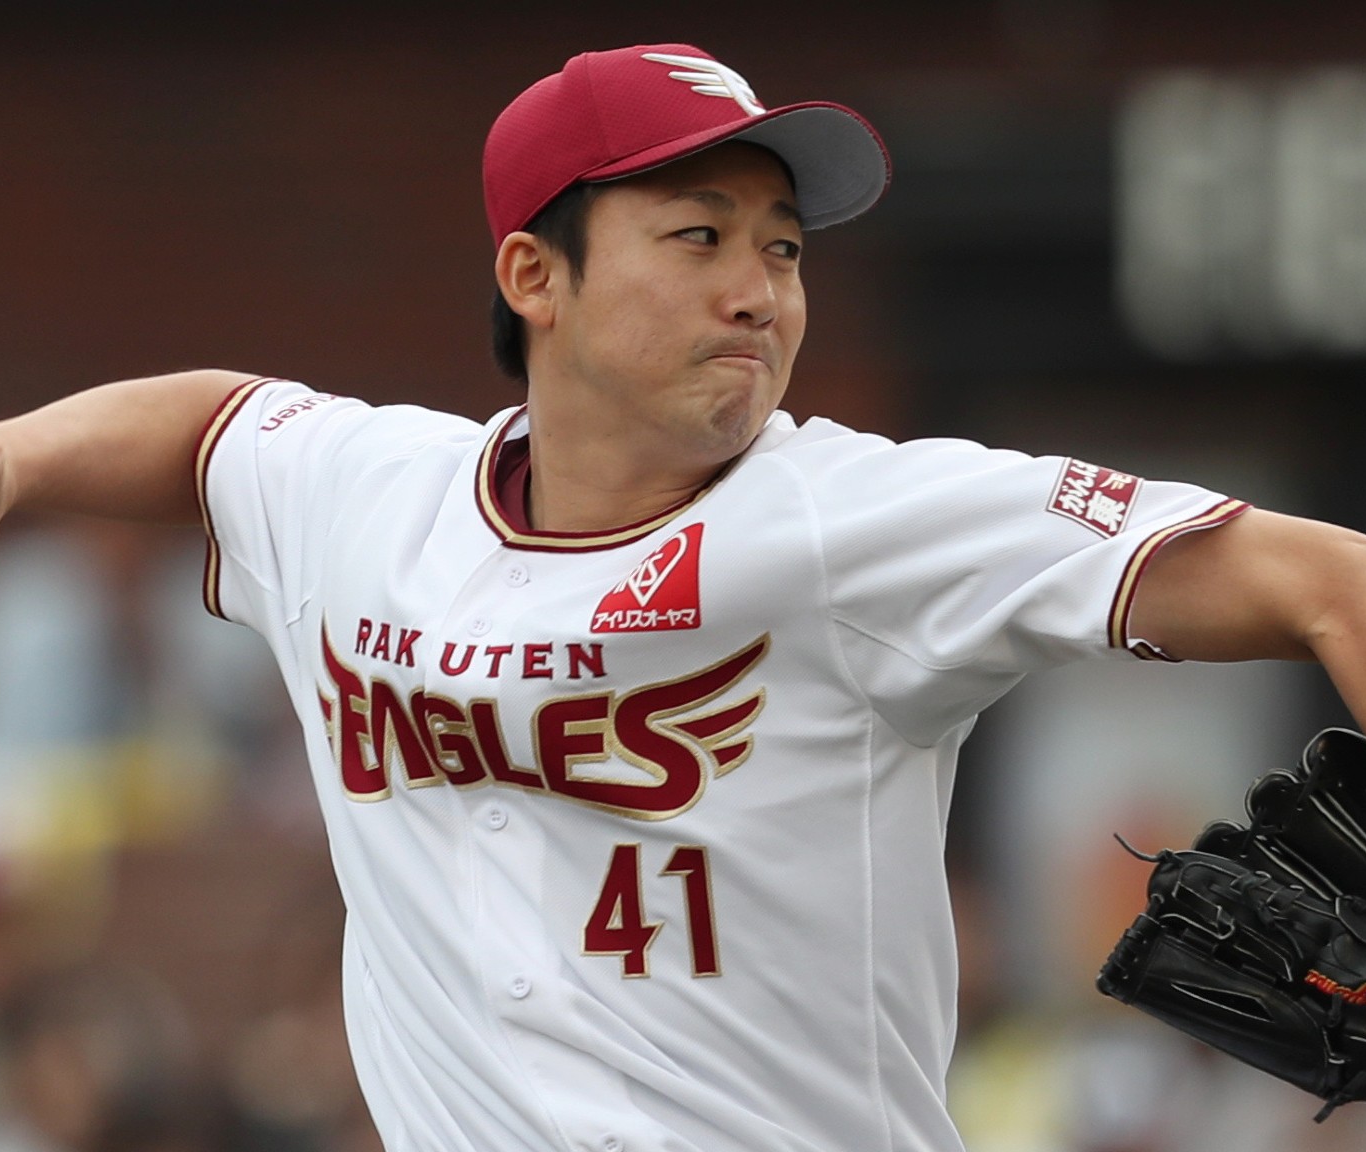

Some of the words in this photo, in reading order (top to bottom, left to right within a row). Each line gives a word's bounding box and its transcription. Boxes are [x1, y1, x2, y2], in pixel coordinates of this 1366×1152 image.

[260, 395, 336, 432] uten
[592, 607, 696, 630] アイリスオーヤマ
[317, 625, 772, 822] EAGLES
[581, 843, 722, 979] 41
